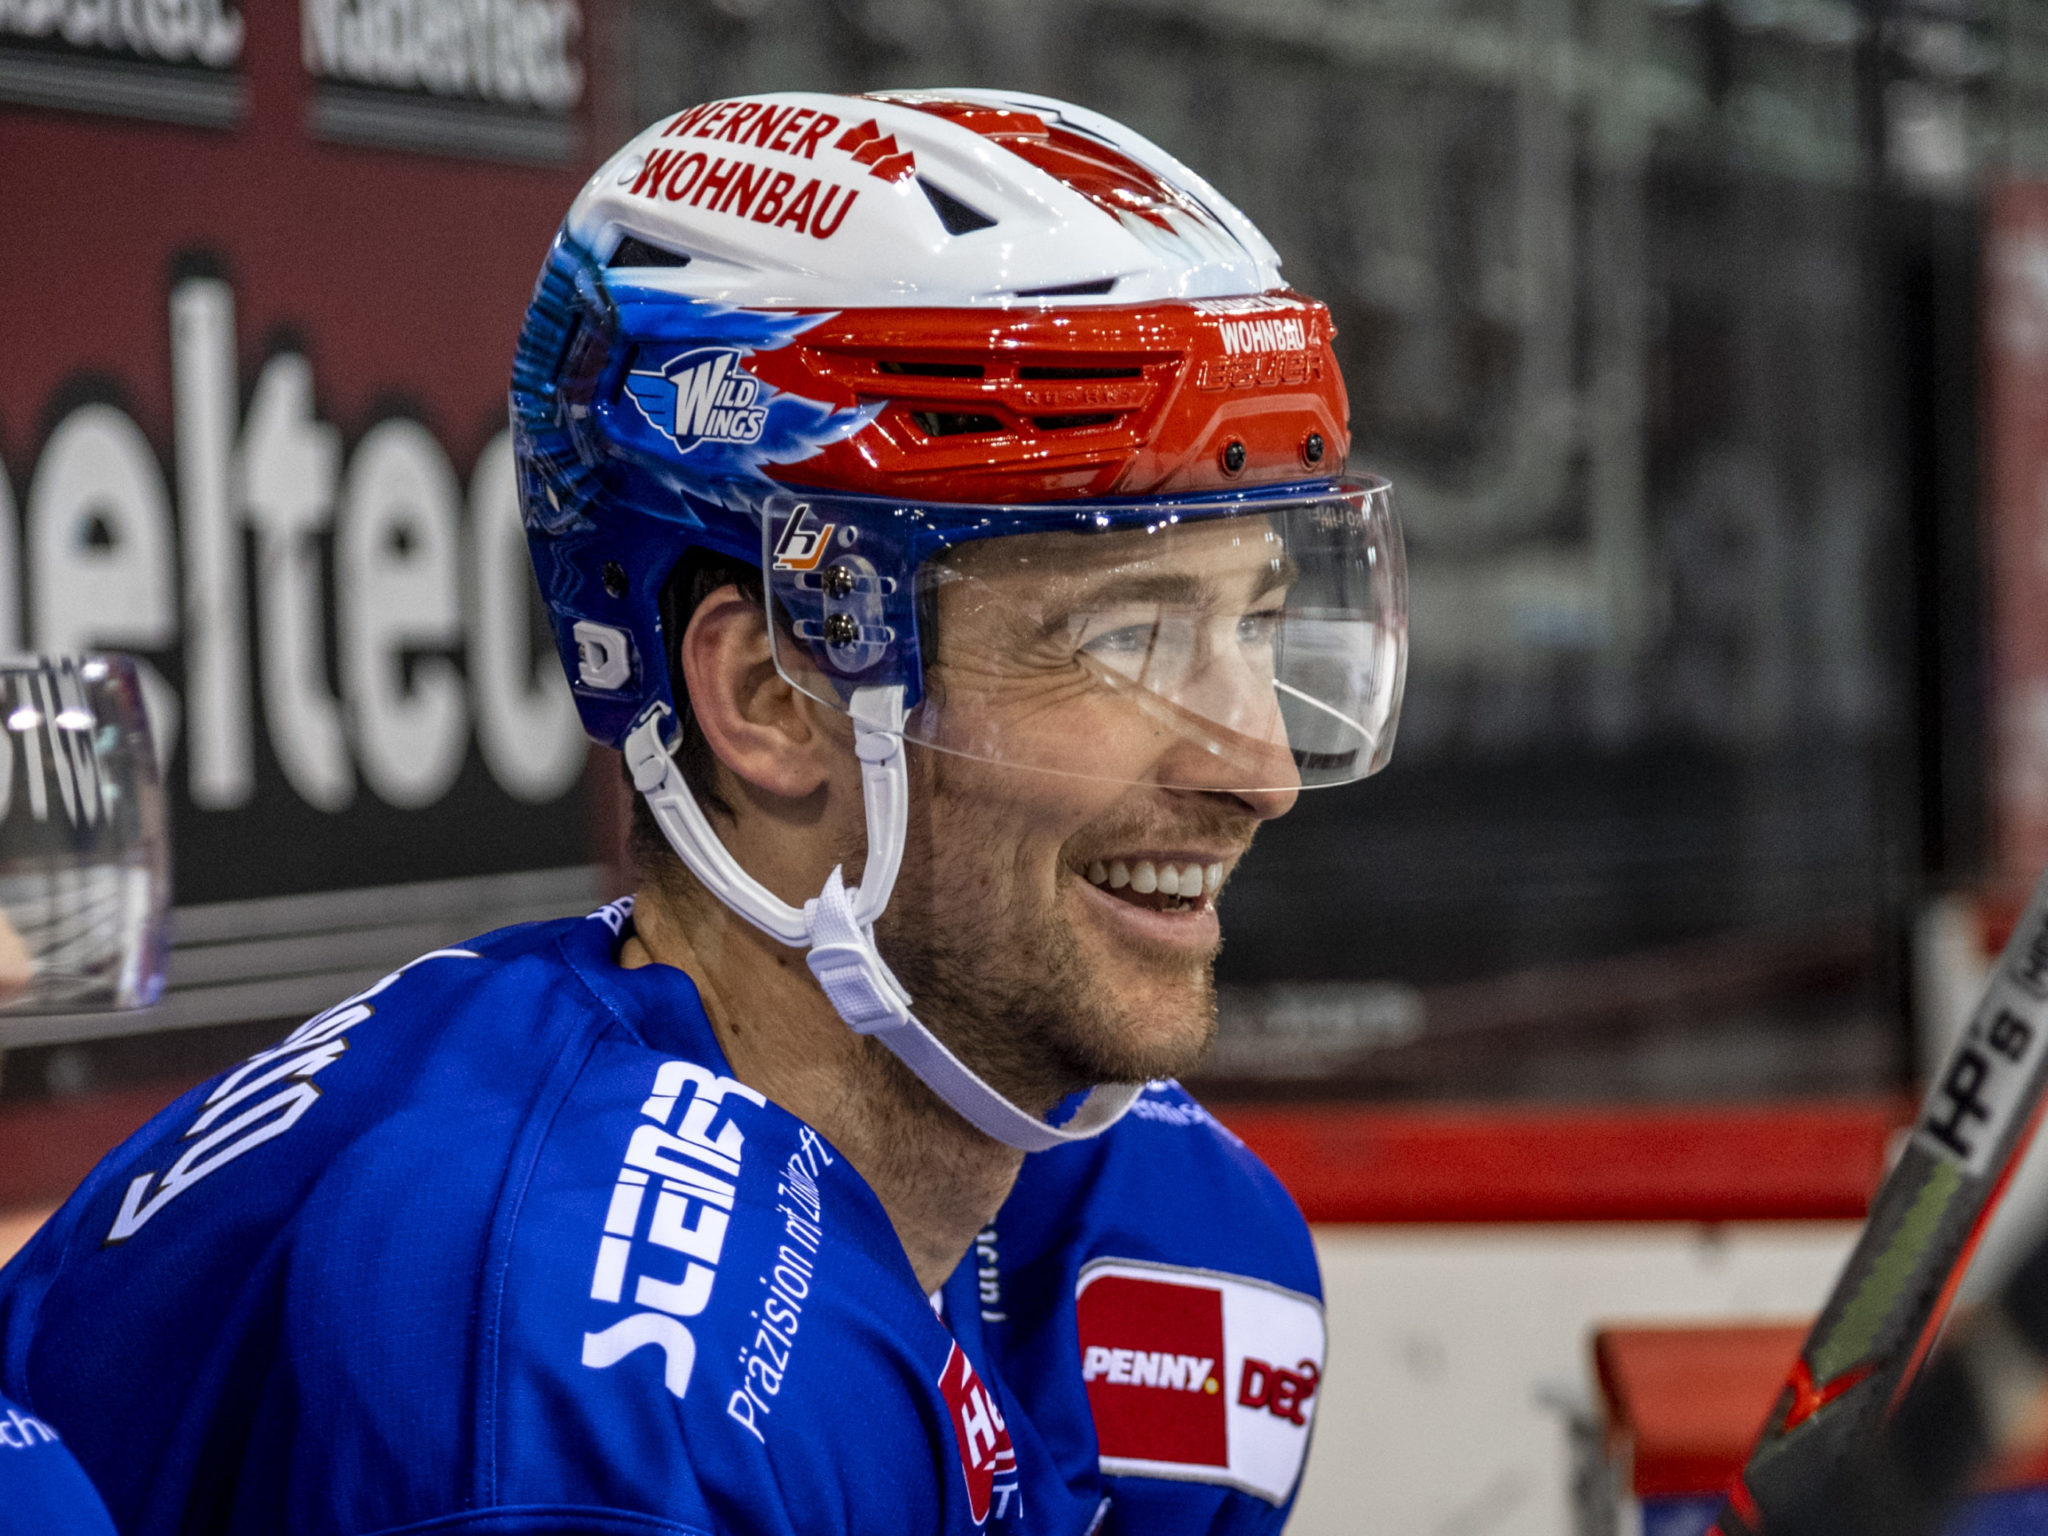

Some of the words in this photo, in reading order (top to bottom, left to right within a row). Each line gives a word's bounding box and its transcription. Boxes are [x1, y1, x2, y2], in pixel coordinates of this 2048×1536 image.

[661, 102, 840, 159] WERNER
[629, 148, 859, 240] WOHNBAU
[1219, 318, 1305, 355] WOHNBAU
[0, 272, 592, 810] eltec
[727, 1245, 813, 1443] Präzision
